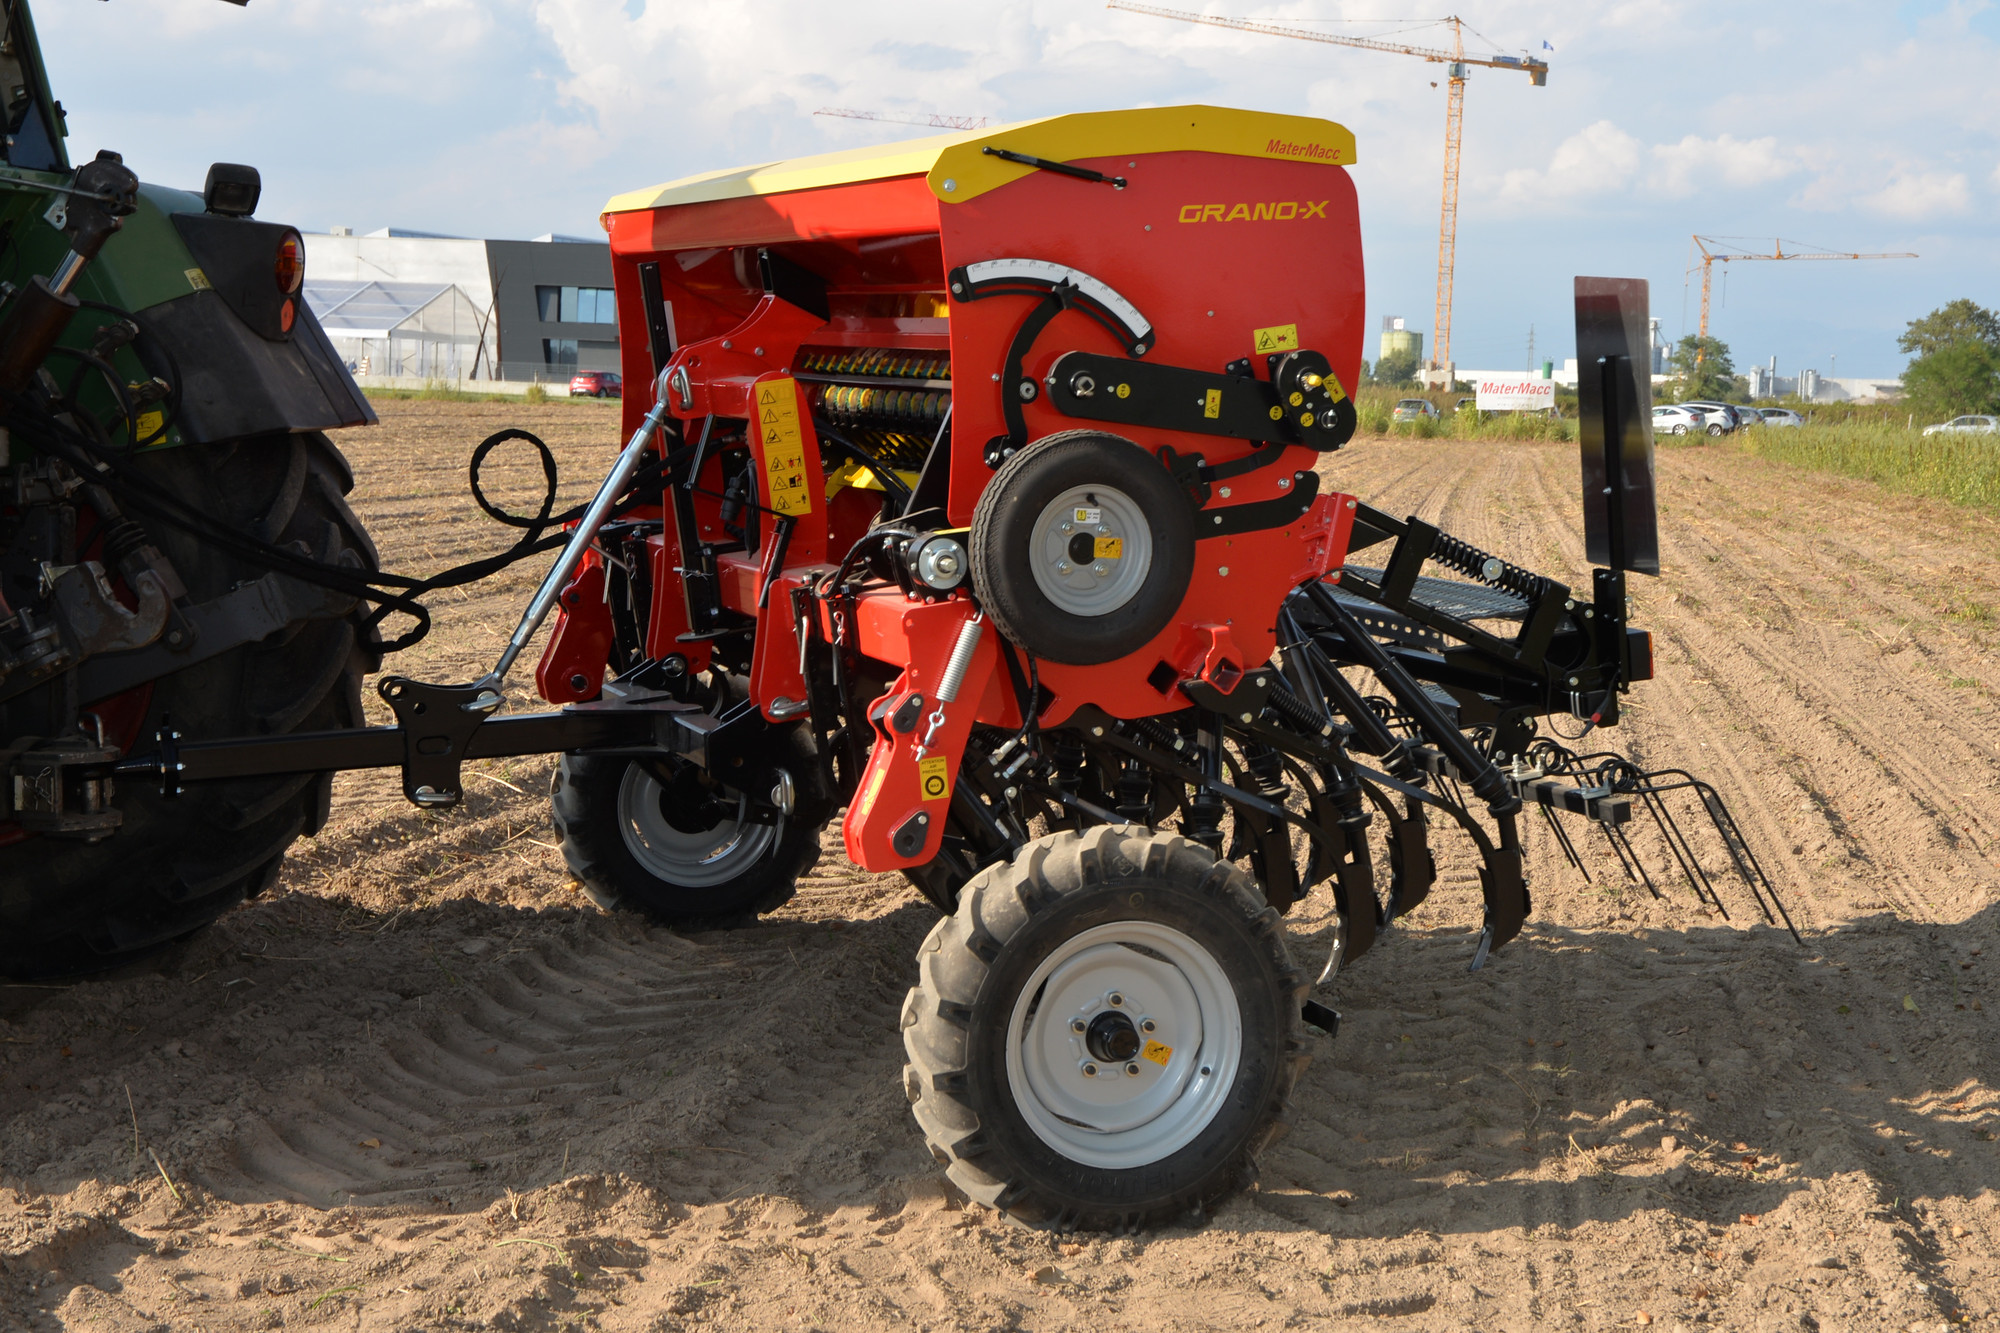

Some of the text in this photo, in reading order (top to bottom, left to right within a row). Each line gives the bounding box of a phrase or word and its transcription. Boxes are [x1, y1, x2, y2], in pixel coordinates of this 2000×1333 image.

[1265, 139, 1341, 160] MaterMacc
[1178, 200, 1330, 223] GRANO-X
[1480, 382, 1552, 395] MaterMacc
